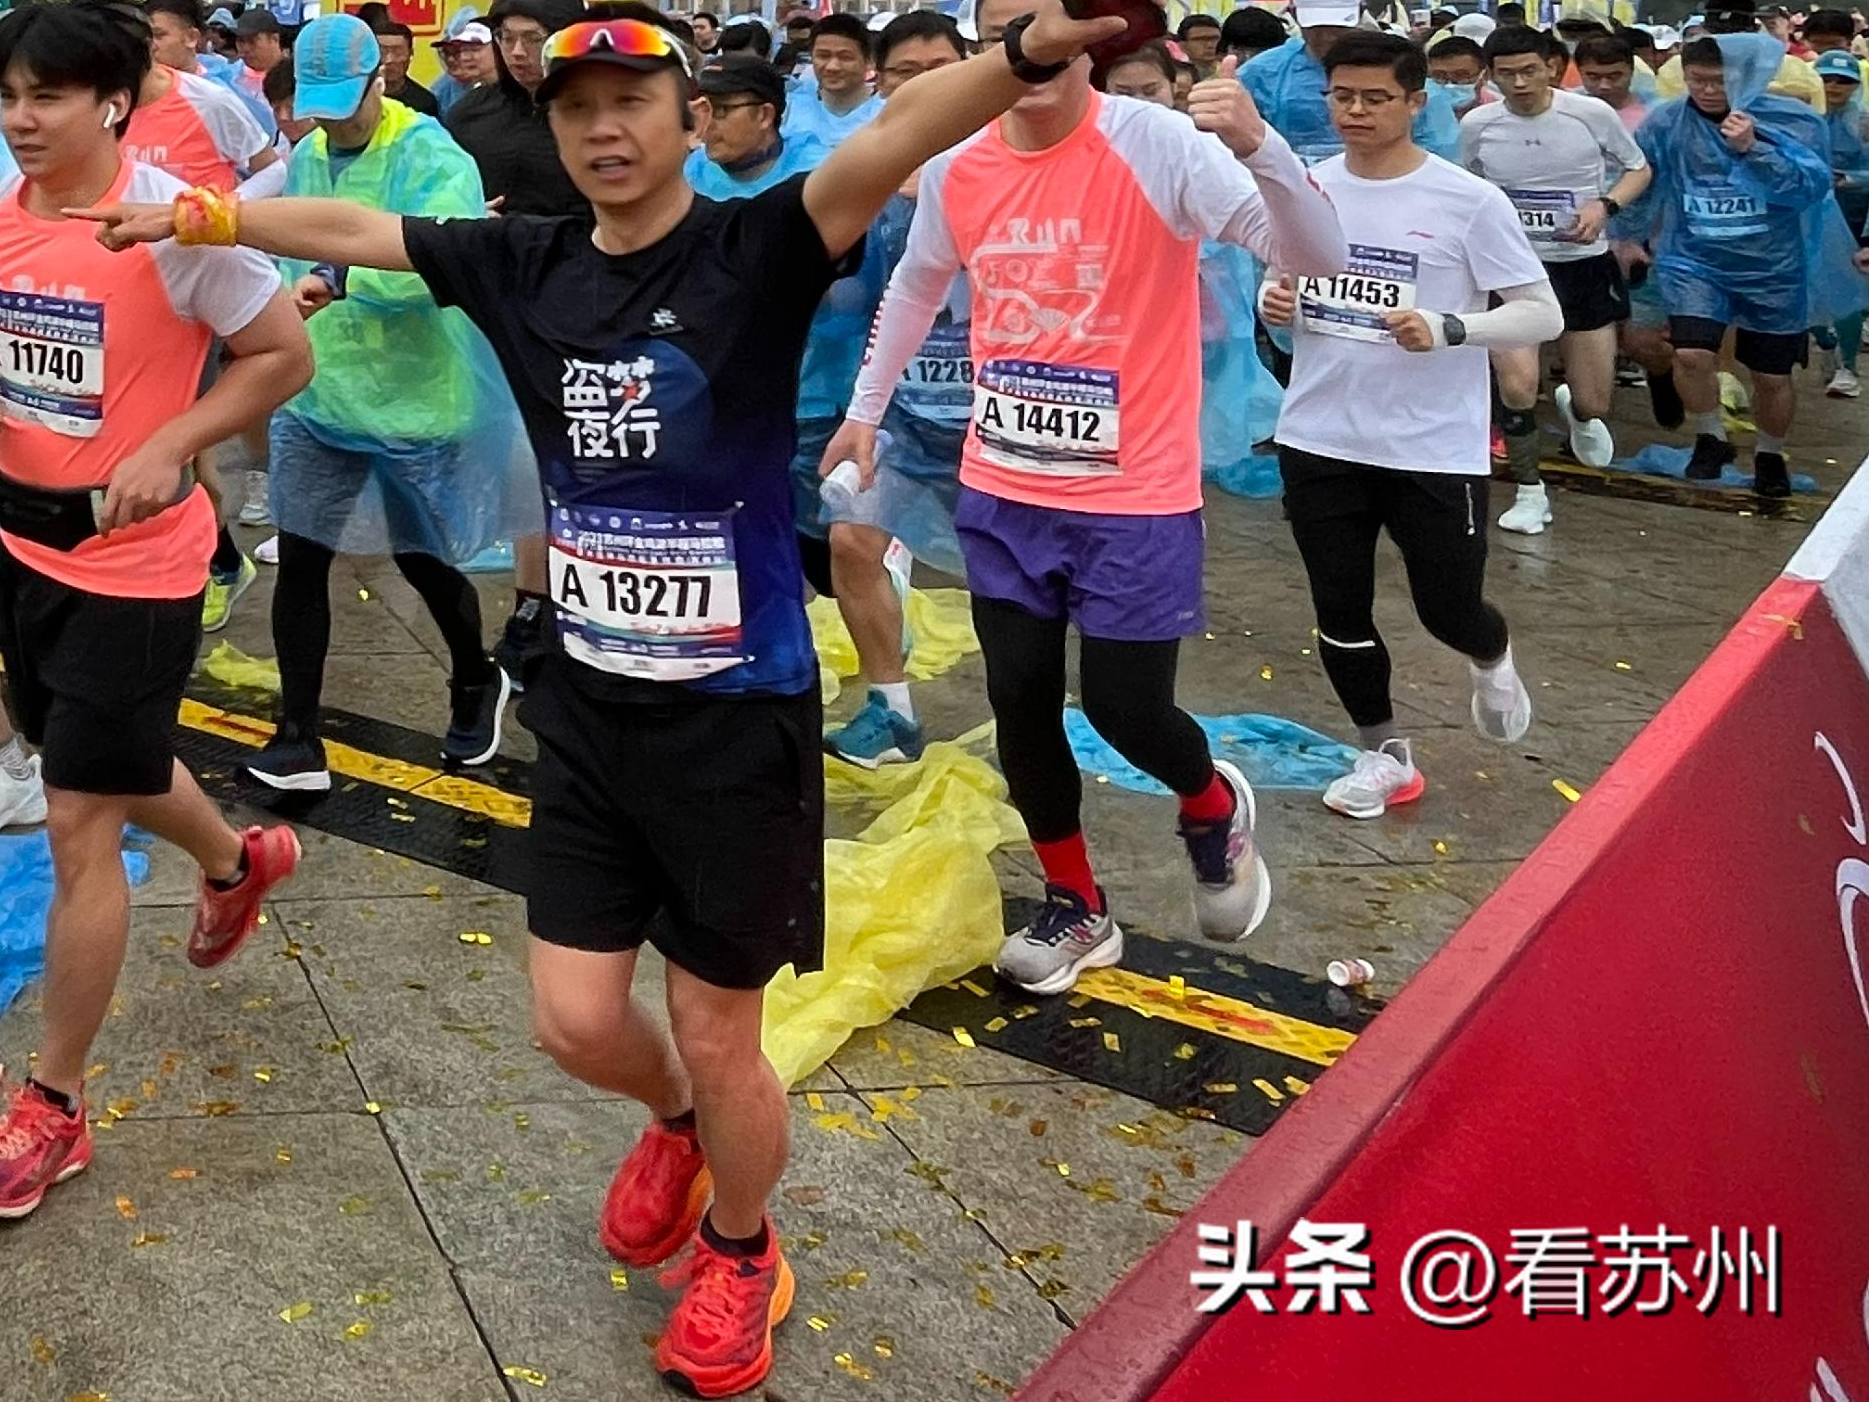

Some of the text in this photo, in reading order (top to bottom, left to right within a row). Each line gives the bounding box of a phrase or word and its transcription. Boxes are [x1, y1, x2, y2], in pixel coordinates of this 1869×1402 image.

[1328, 275, 1400, 309] 11453
[8, 339, 84, 385] 11740
[563, 409, 661, 460] 夜行
[981, 397, 1101, 442] A 14412
[560, 563, 712, 619] A 13277
